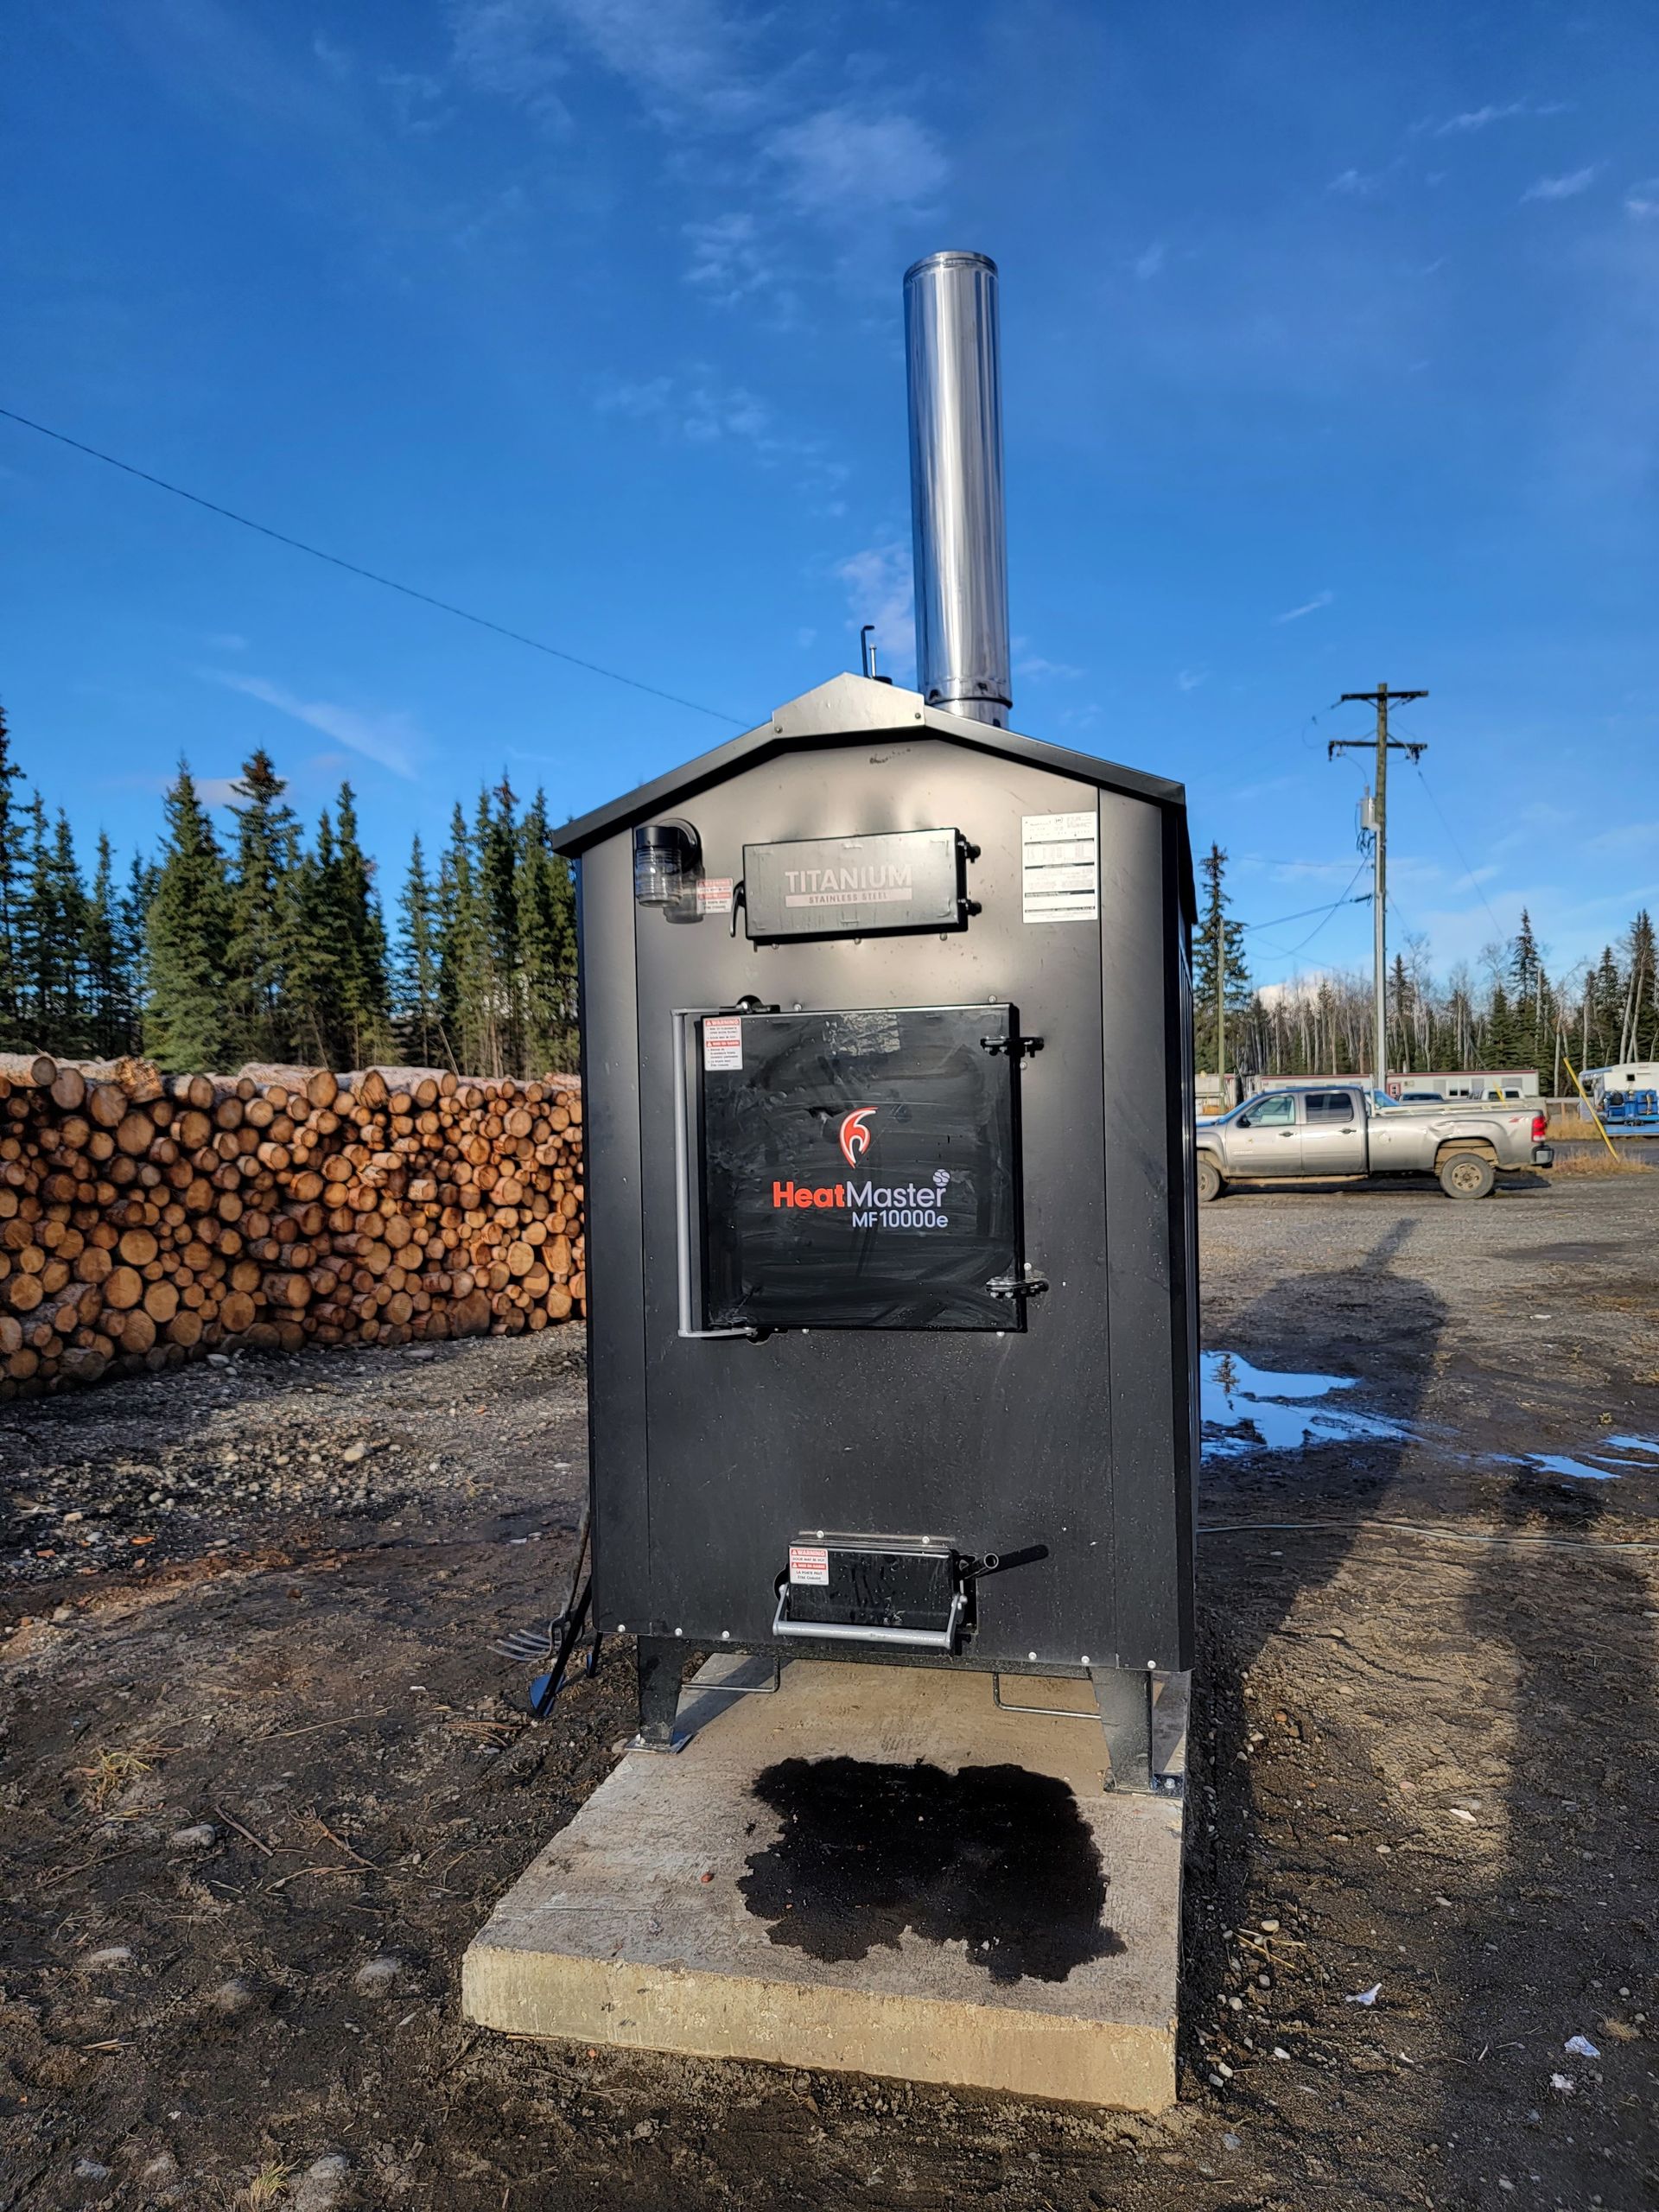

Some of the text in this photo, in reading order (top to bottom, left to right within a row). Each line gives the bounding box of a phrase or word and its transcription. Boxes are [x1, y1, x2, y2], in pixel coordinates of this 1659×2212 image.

[785, 865, 912, 893] TITANIUM
[809, 892, 887, 904] STAINLESS STEEL
[772, 1180, 947, 1208] HeatMaster
[852, 1210, 949, 1228] MF10000e
